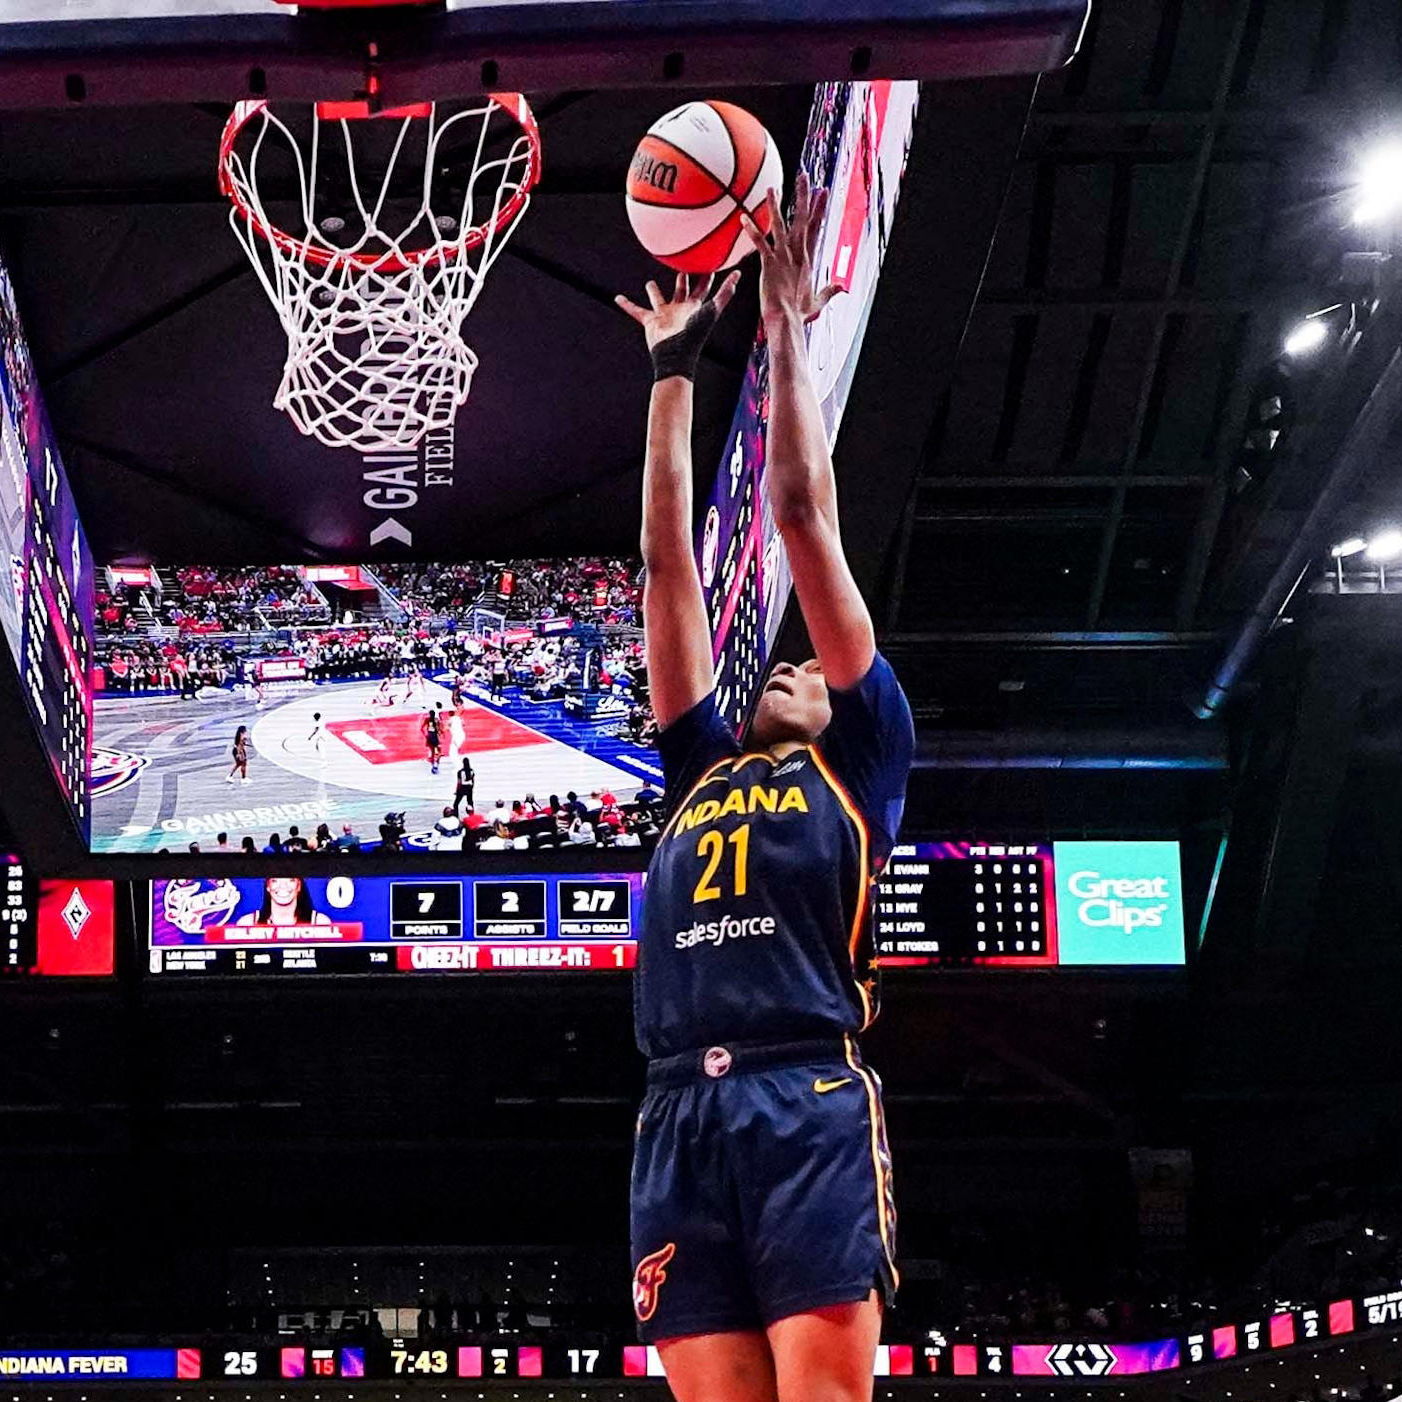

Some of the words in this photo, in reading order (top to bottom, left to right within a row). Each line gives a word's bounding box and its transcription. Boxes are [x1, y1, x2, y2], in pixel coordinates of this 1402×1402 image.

[673, 786, 809, 839] NDANA
[694, 824, 750, 903] 21
[326, 876, 355, 908] 0
[1067, 871, 1169, 899] Great
[417, 892, 435, 913] 7
[501, 892, 519, 912] 2
[573, 890, 616, 912] 2/7
[1077, 899, 1165, 934] Clips
[676, 916, 775, 949] salesforce
[612, 945, 624, 966] 1
[1305, 1318, 1318, 1338] 2
[1246, 1330, 1260, 1351] 5
[68, 1356, 128, 1374] FEVER
[224, 1351, 258, 1375] 25
[312, 1358, 334, 1376] 15
[390, 1350, 448, 1374] 7:43
[493, 1358, 506, 1375] 2
[567, 1349, 599, 1373] 17
[927, 1356, 937, 1373] 1
